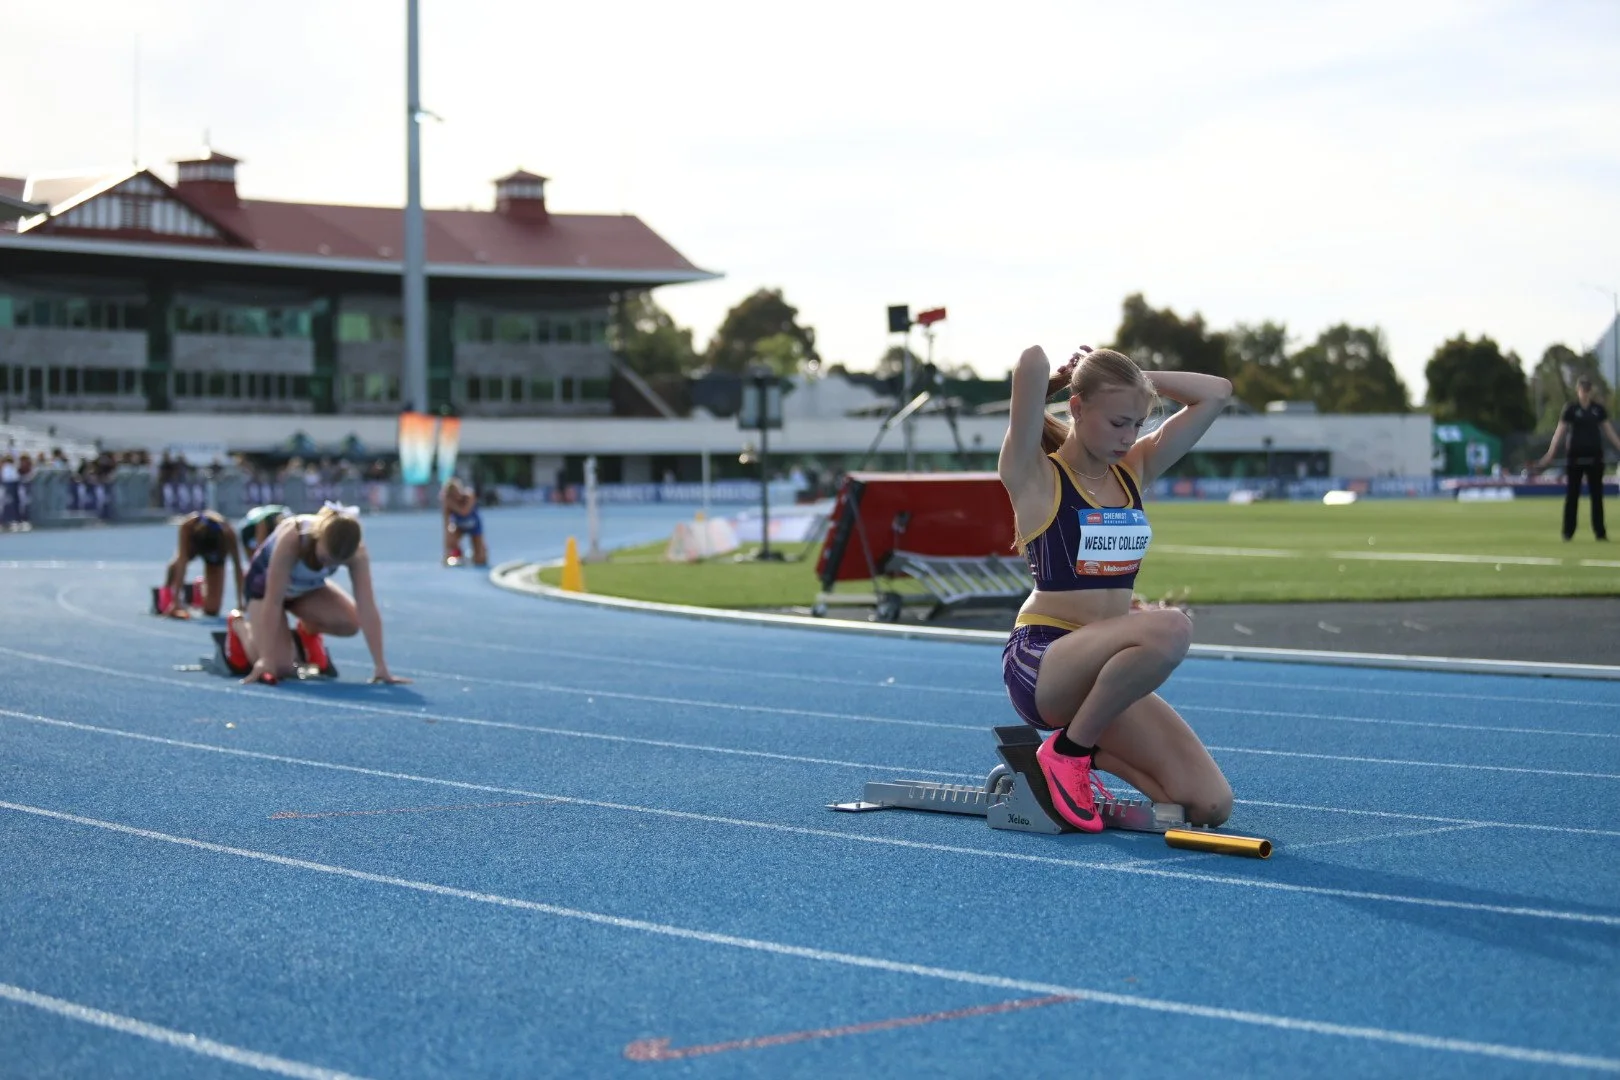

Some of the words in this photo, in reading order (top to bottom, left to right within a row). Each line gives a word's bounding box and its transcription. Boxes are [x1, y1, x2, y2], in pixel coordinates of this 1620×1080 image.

[1103, 512, 1127, 520] CHEMIST
[1084, 536, 1117, 550] WESLEY
[1118, 536, 1148, 550] COLLEGE
